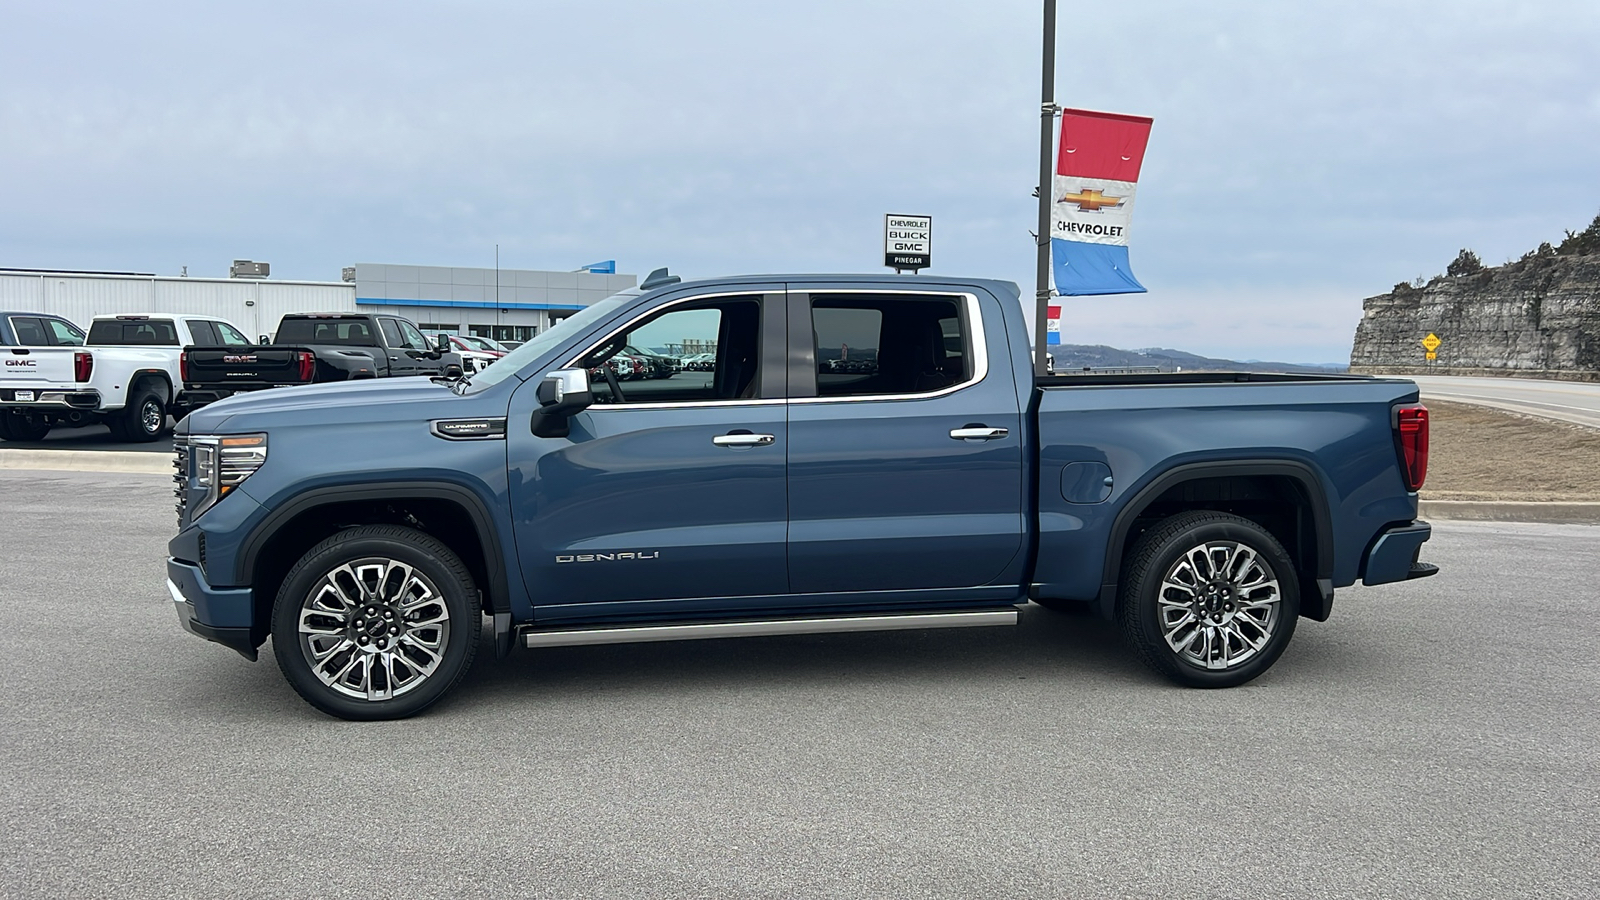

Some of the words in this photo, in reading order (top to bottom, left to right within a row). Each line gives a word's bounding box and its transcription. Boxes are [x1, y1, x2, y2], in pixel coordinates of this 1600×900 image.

[890, 220, 928, 228] CHEVROLET
[1057, 221, 1123, 237] CHEVROLET
[889, 231, 928, 240] BUICK
[894, 243, 923, 251] GMC
[223, 355, 257, 363] GMC
[555, 551, 659, 563] DENALI
